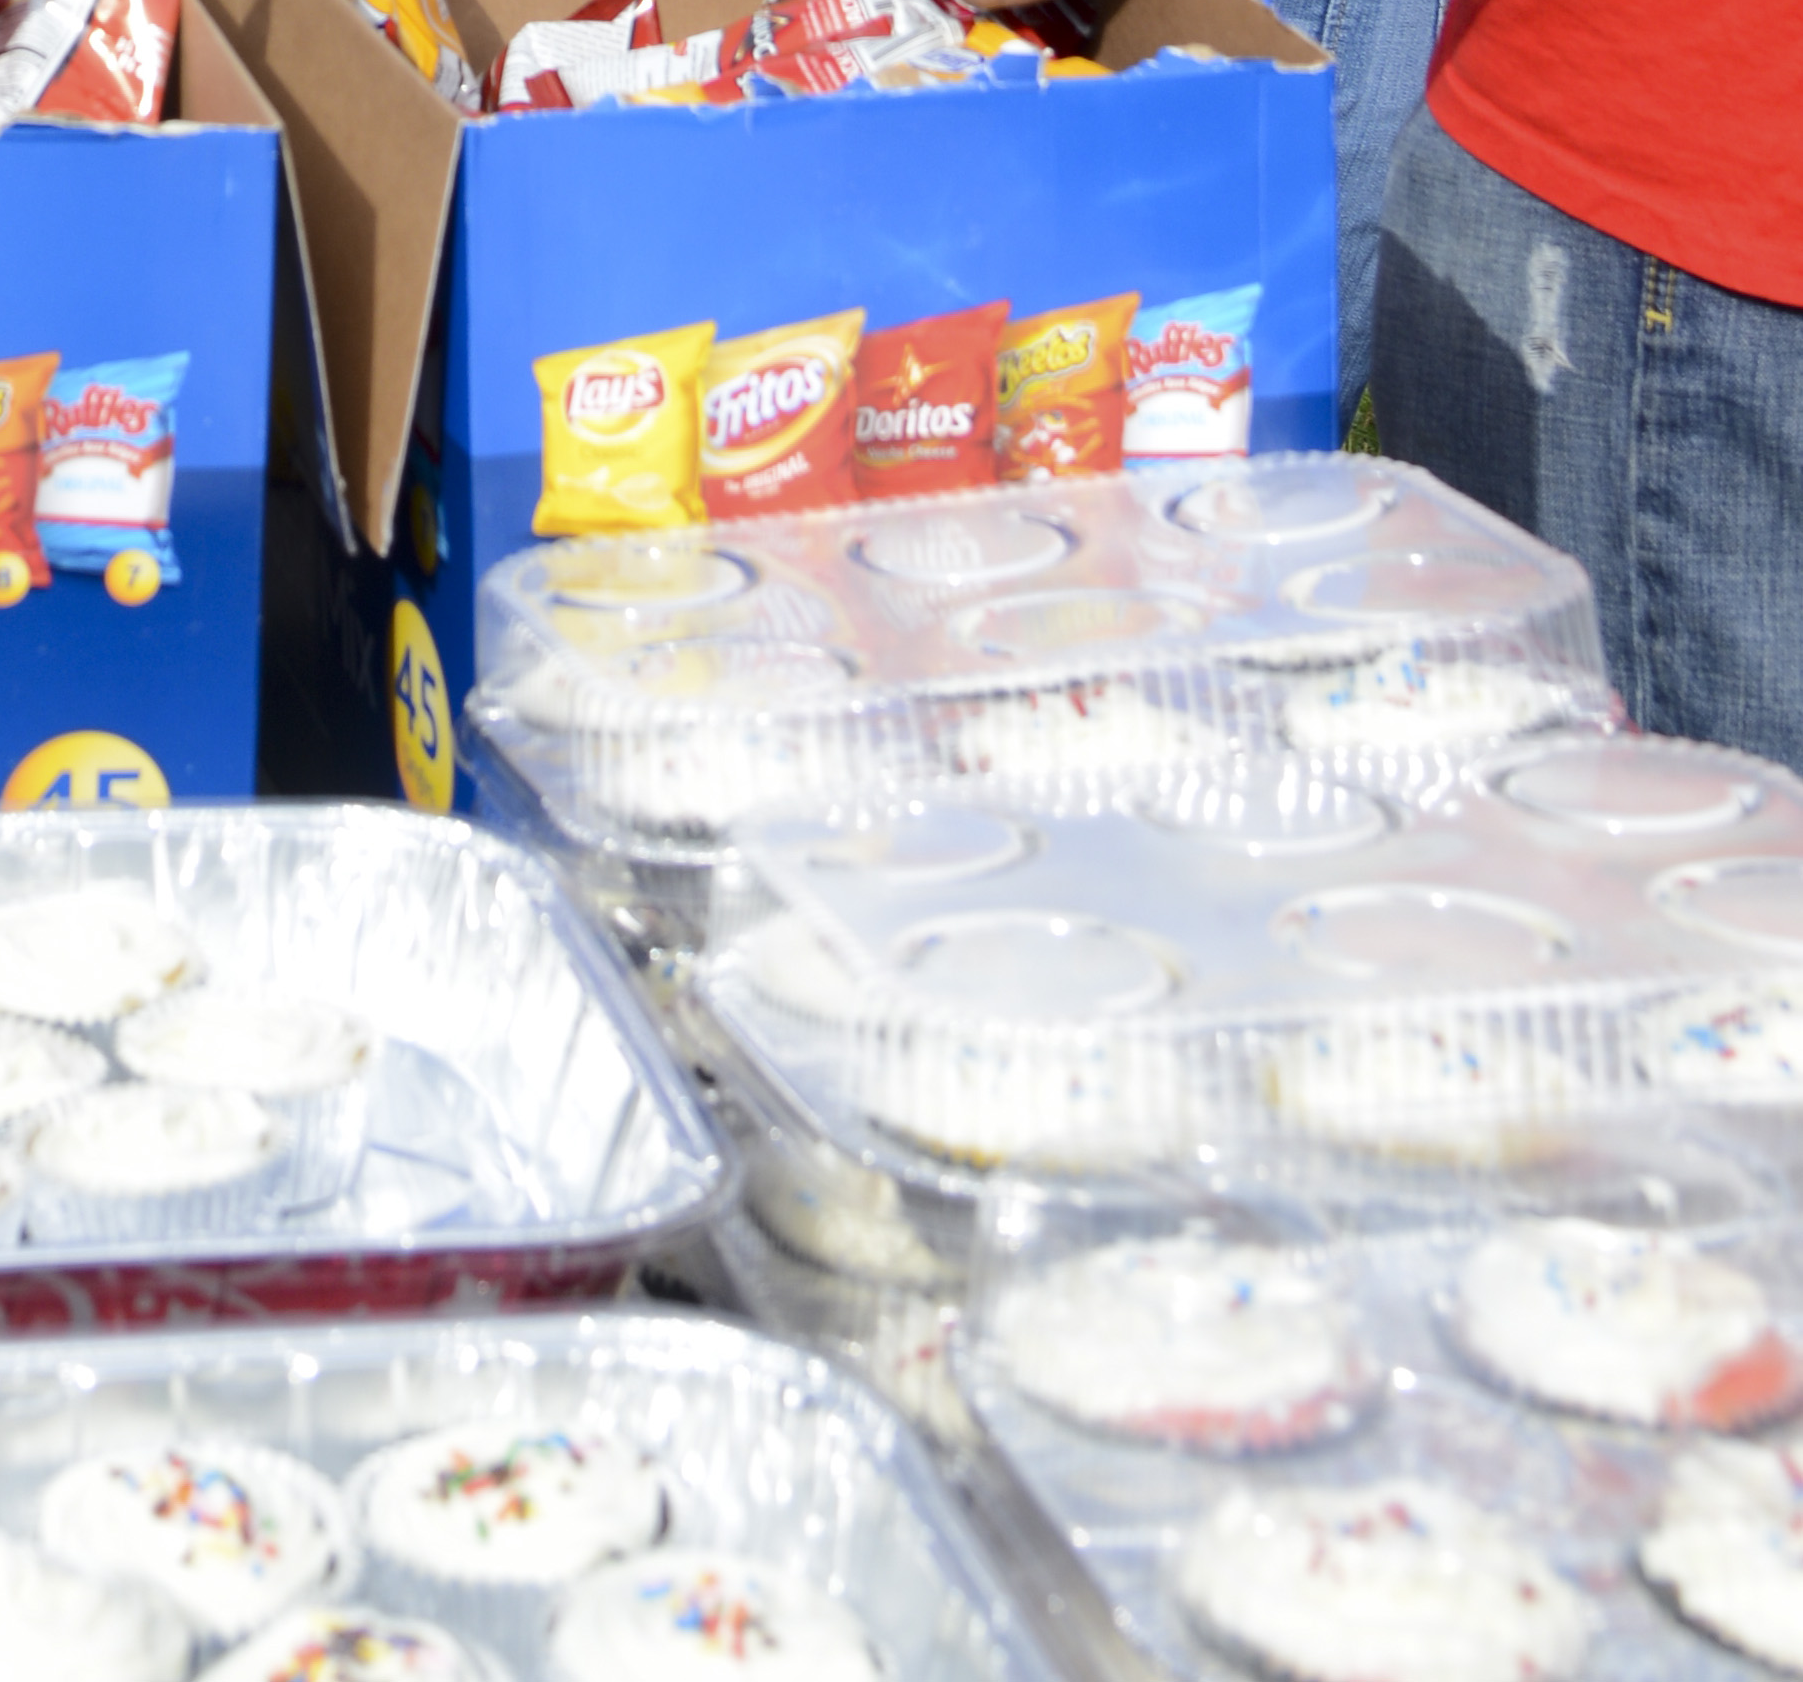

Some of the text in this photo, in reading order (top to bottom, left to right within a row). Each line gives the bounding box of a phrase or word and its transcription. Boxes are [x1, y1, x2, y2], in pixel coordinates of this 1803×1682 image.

[1127, 320, 1235, 376] Ruffles
[43, 384, 159, 438] Ruffles
[702, 357, 826, 449] Fritos
[854, 398, 975, 443] Doritos
[126, 565, 143, 589] 7
[397, 643, 438, 761] 45
